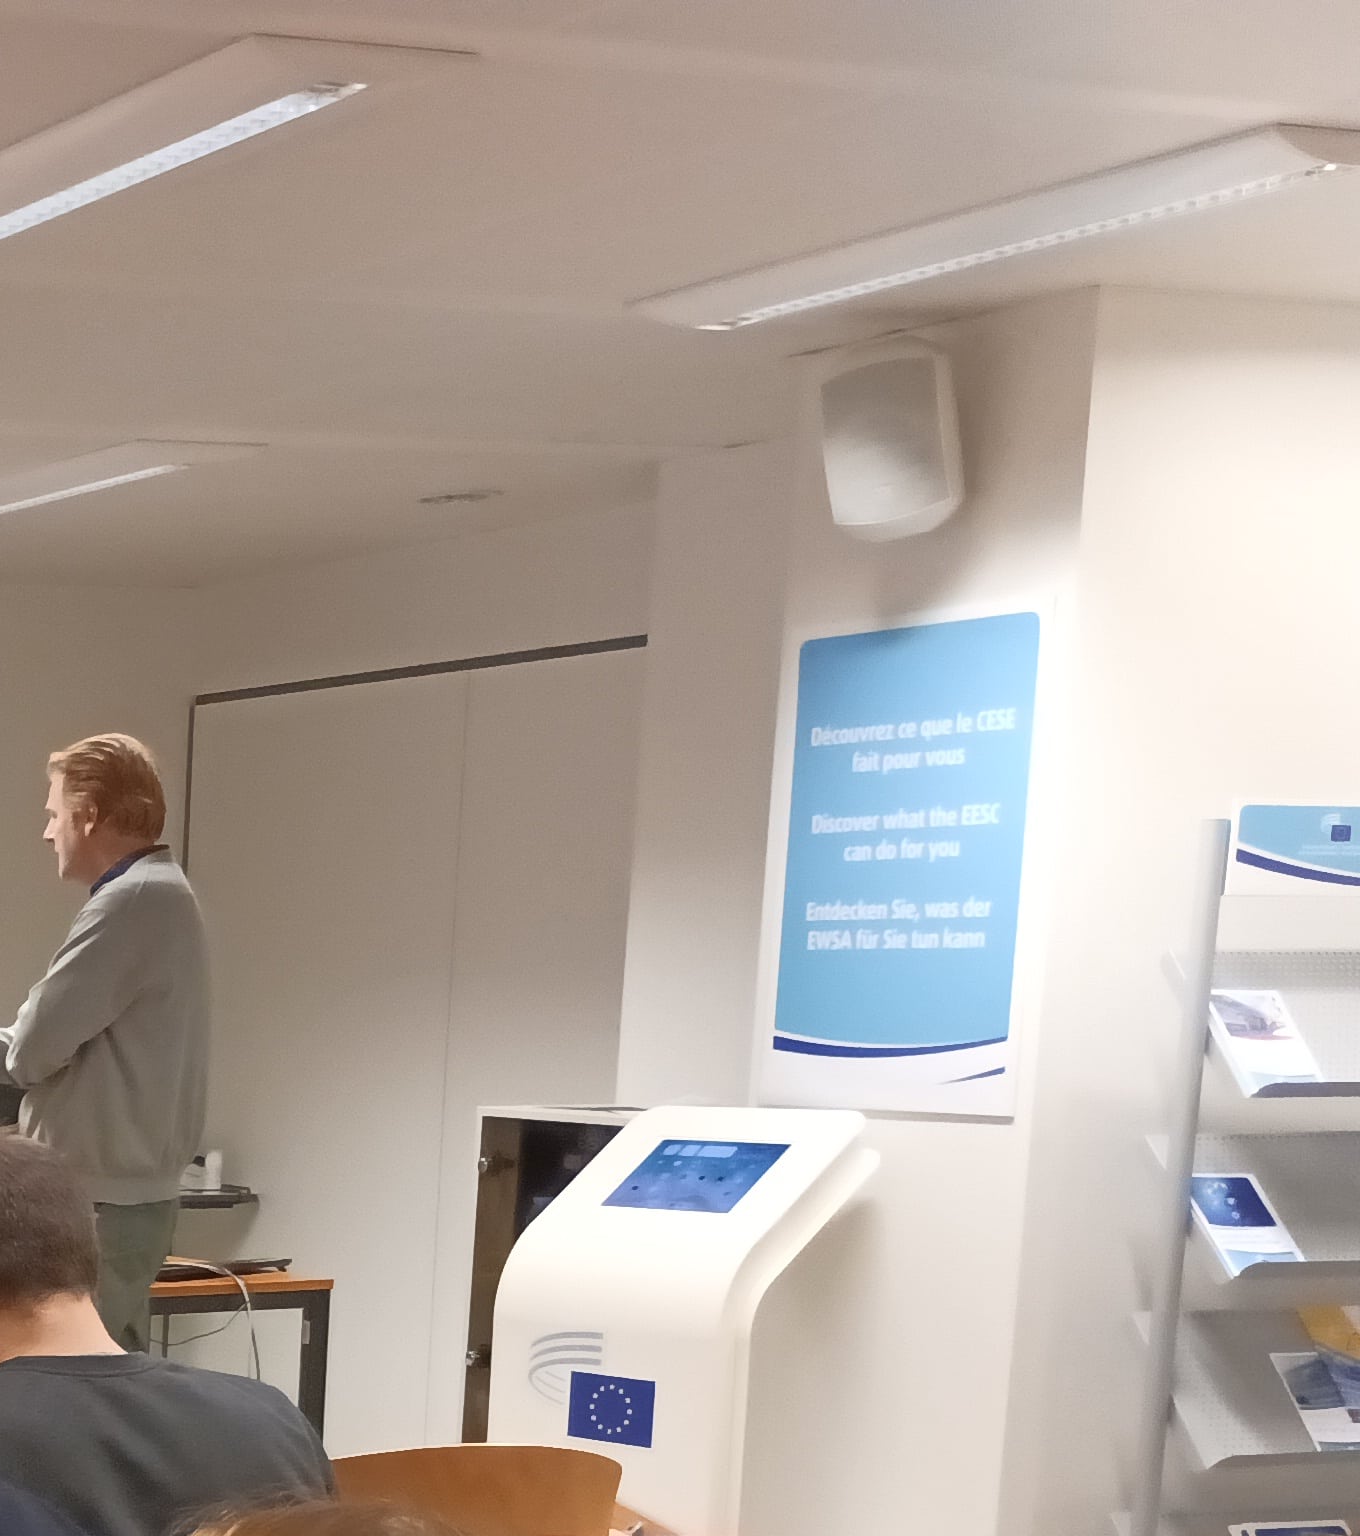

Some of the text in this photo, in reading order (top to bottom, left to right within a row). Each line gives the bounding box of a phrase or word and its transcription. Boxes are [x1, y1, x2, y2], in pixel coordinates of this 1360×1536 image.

[897, 722, 916, 738] ce
[920, 718, 953, 741] que
[956, 712, 972, 733] le
[976, 708, 1017, 731] CESE
[851, 748, 965, 774] fait pour vous
[811, 803, 1001, 835] Discover what the EESC
[843, 838, 961, 863] can do for you
[806, 896, 992, 923] Entdecken Sie, was der
[807, 926, 986, 951] EWSA für Sie tun kann
